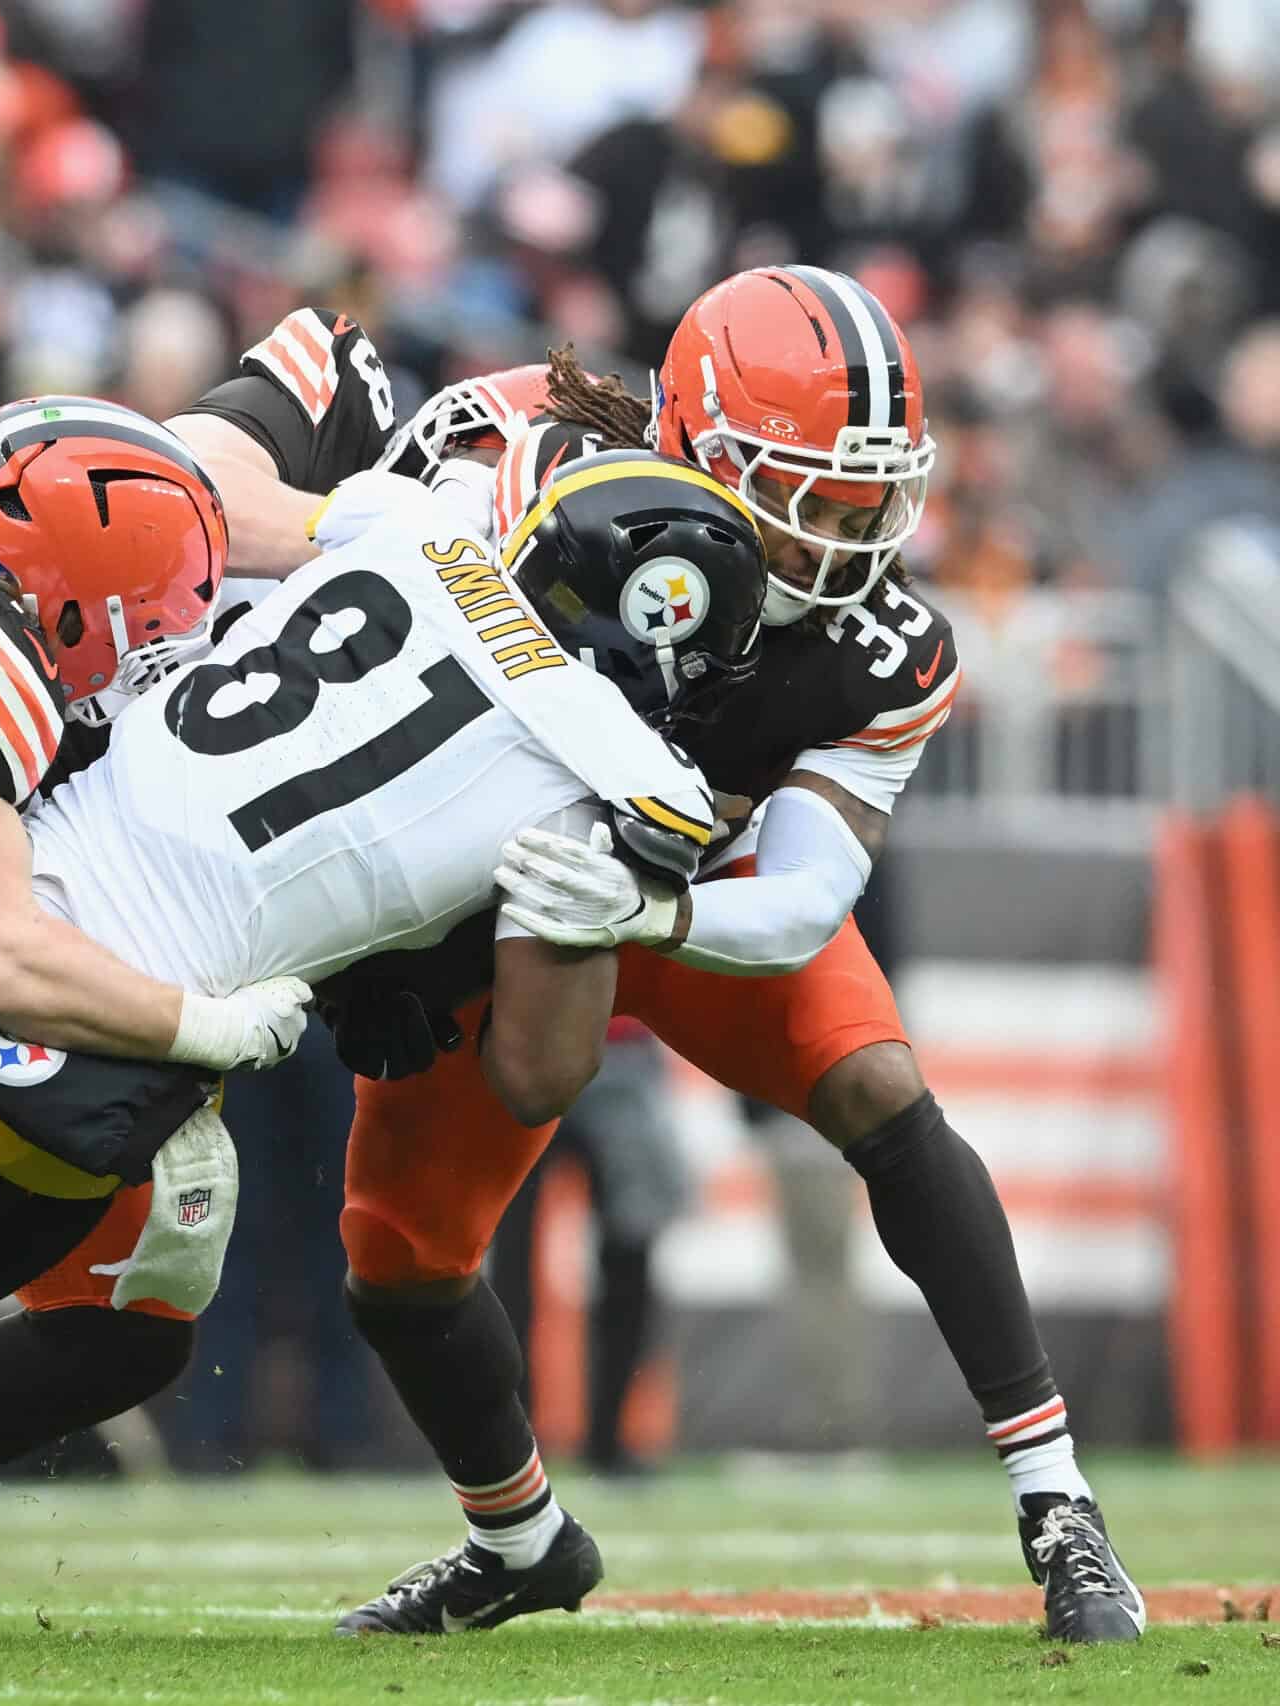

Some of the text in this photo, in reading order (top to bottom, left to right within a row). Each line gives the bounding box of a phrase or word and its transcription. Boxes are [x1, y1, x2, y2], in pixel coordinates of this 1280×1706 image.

[422, 538, 568, 681] SMITH
[638, 582, 666, 604] Steelers
[826, 576, 933, 678] 33
[164, 570, 495, 852] 81
[181, 1203, 208, 1223] NFL
